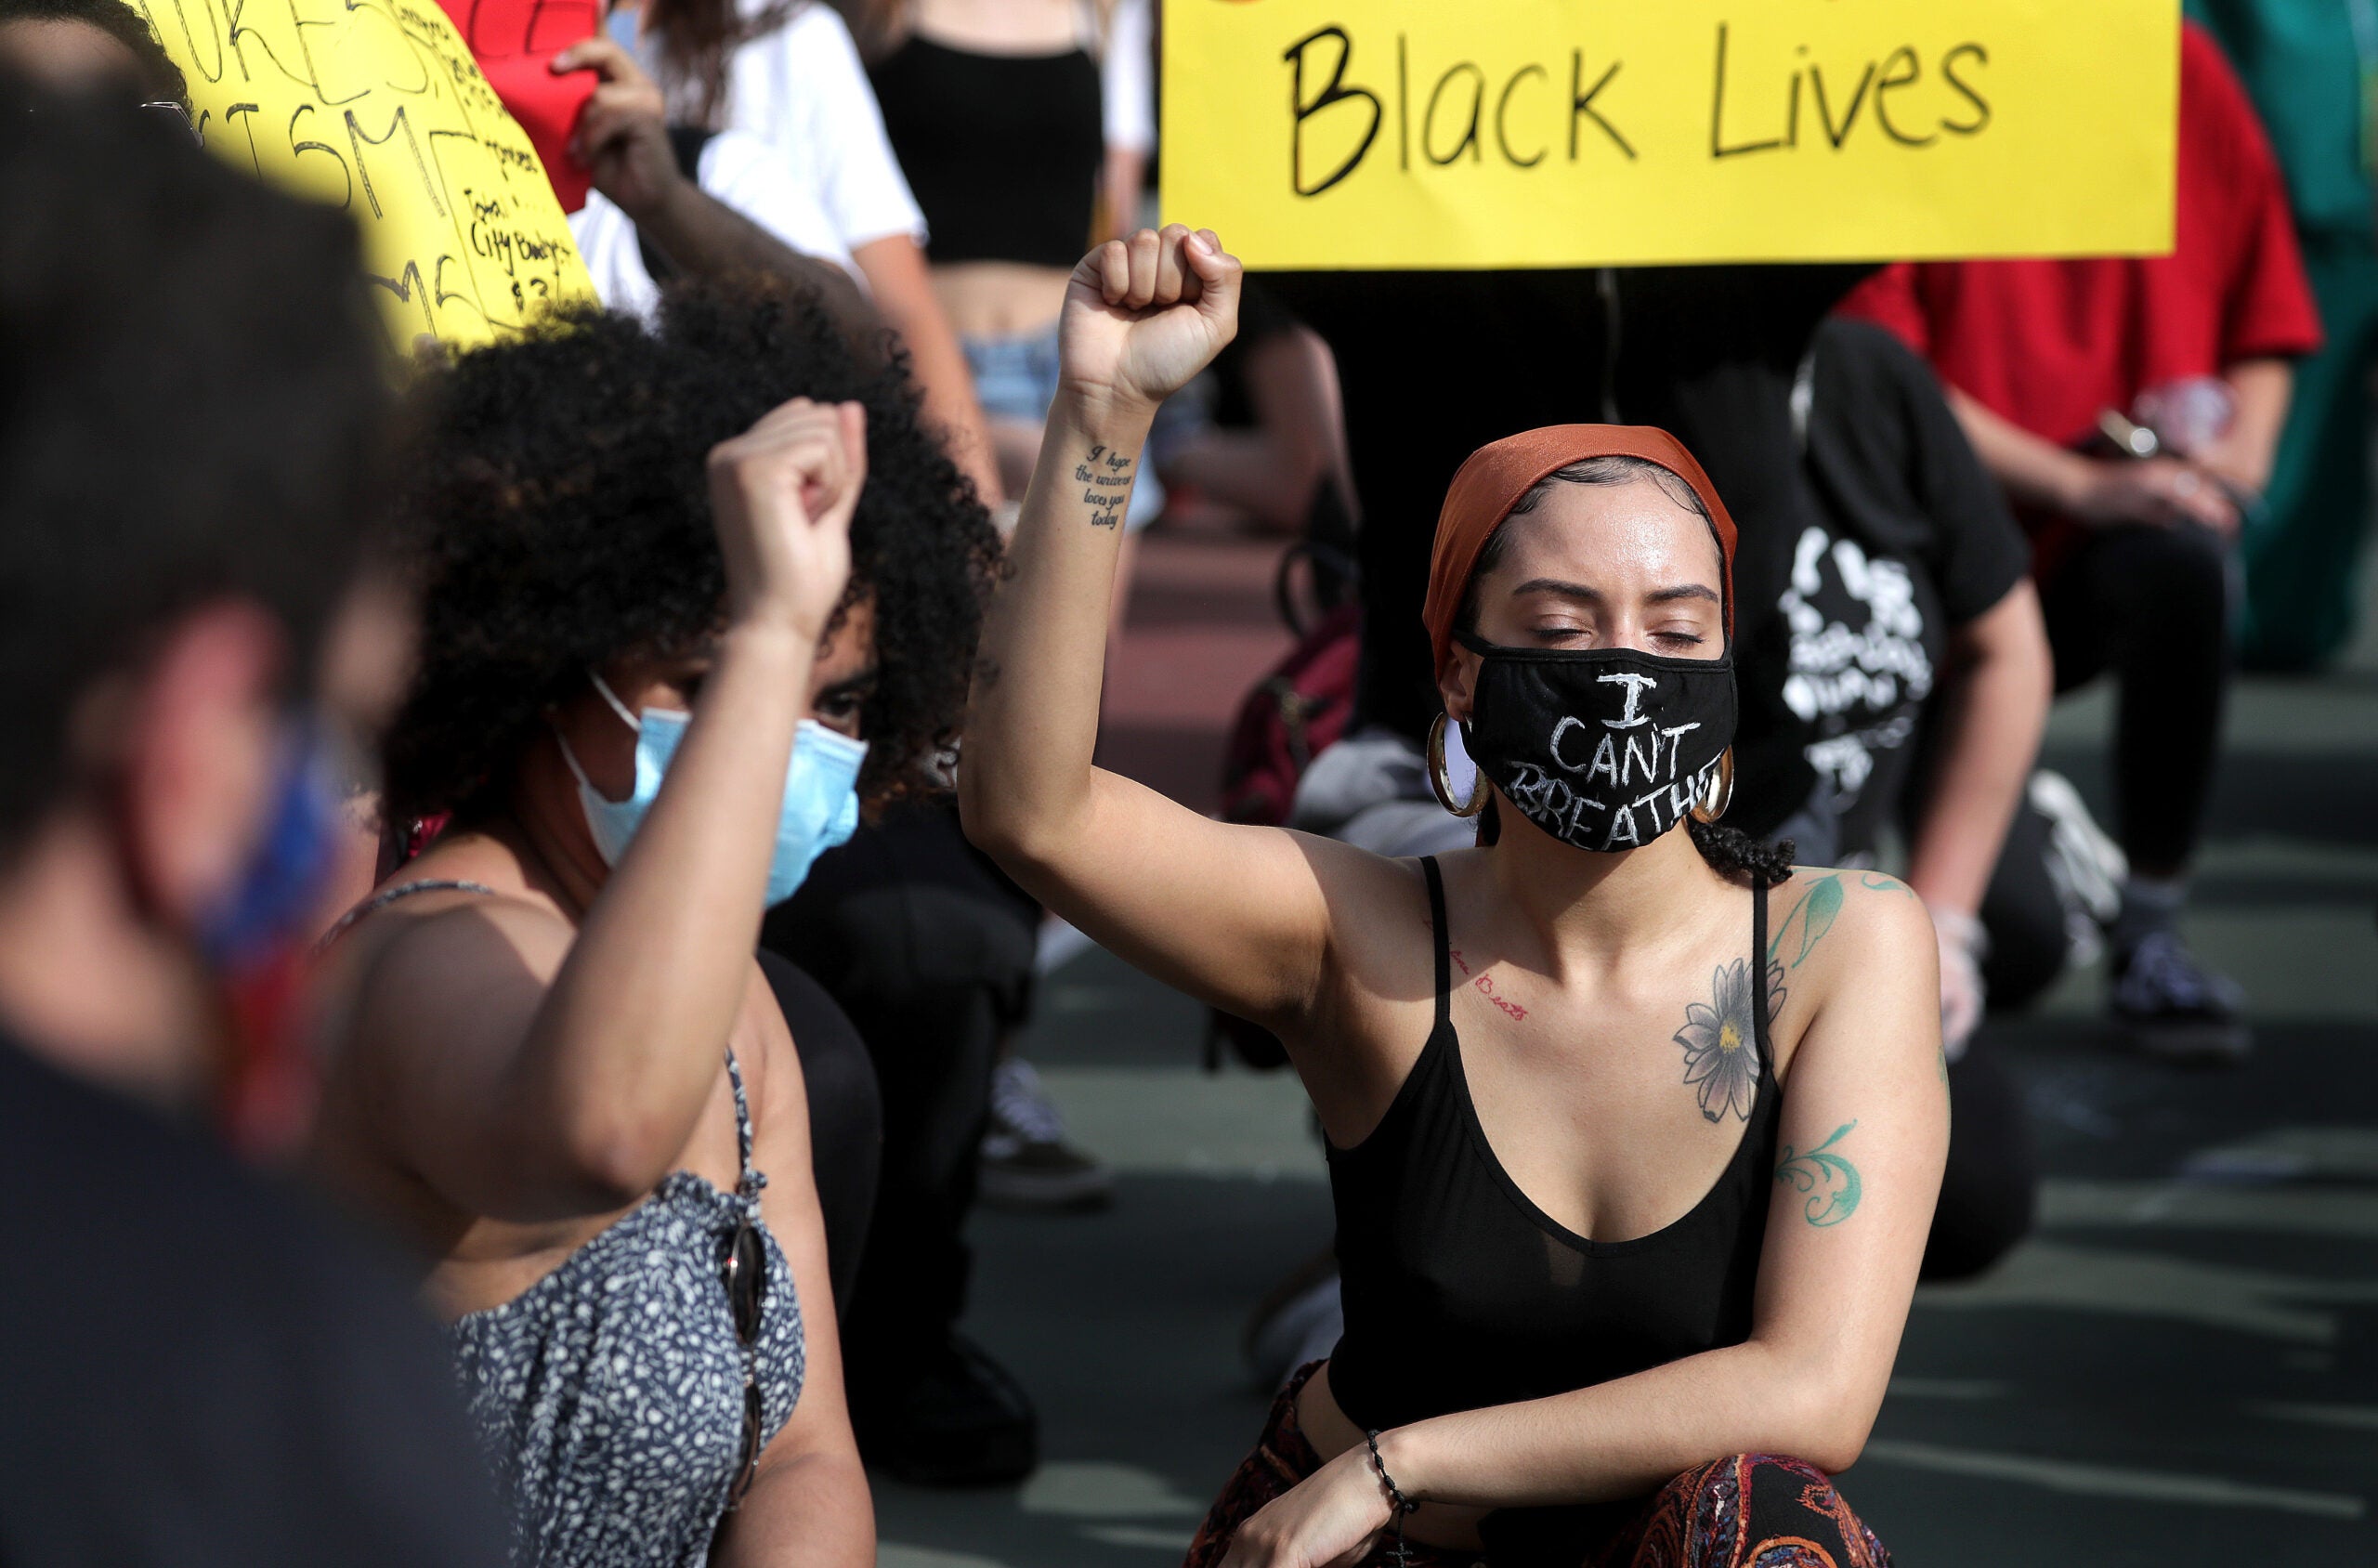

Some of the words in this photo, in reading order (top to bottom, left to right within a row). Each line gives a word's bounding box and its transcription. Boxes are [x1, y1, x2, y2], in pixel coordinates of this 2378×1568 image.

[1282, 23, 1638, 198] Black
[1711, 22, 1993, 159] Lives
[1087, 445, 1106, 462] I
[1106, 452, 1130, 472] hope
[1076, 464, 1092, 482] the
[1084, 489, 1106, 505] loves
[1106, 495, 1125, 510] you
[1091, 511, 1118, 529] today
[1596, 672, 1658, 728] I
